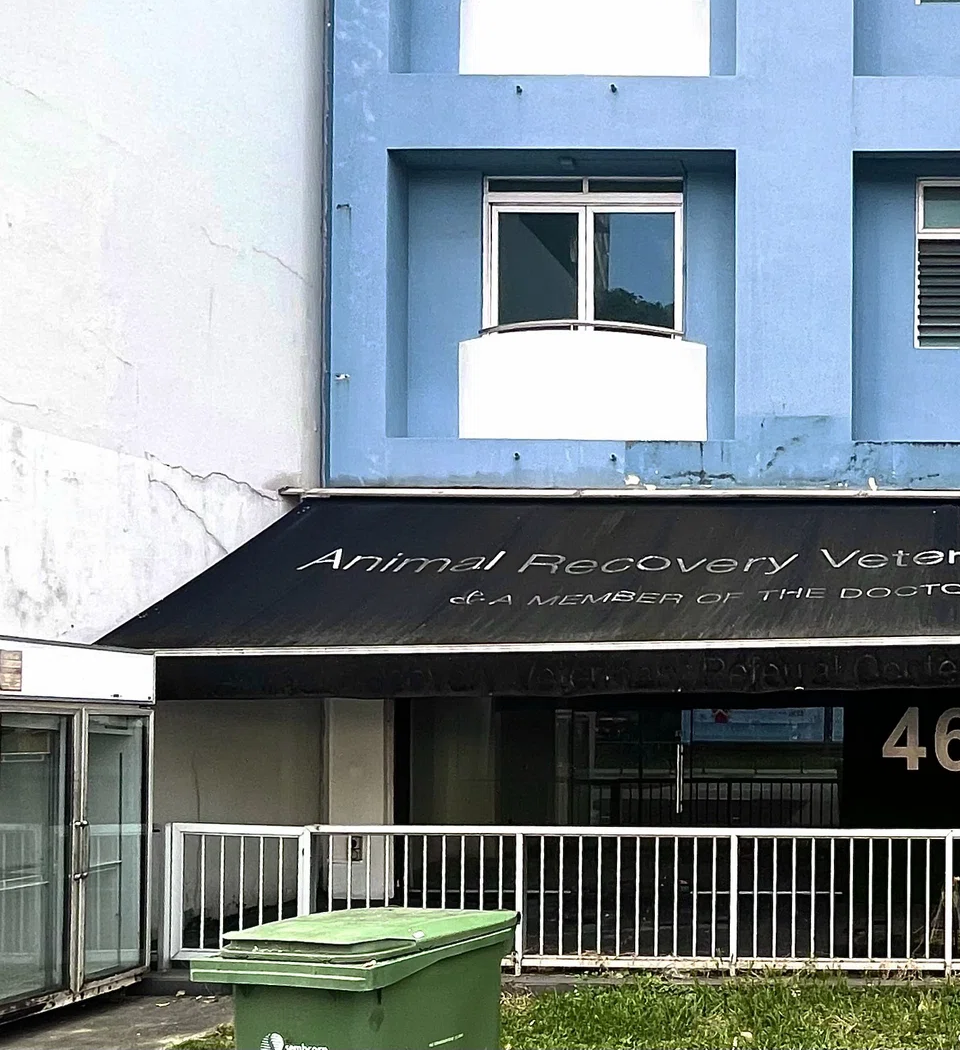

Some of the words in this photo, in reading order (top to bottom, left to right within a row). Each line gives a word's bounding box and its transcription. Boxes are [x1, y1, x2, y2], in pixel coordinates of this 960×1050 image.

[297, 548, 507, 574] Animal
[517, 552, 799, 575] Recovery
[526, 589, 684, 606] MEMBER
[696, 591, 744, 605] OF
[757, 587, 827, 602] THE
